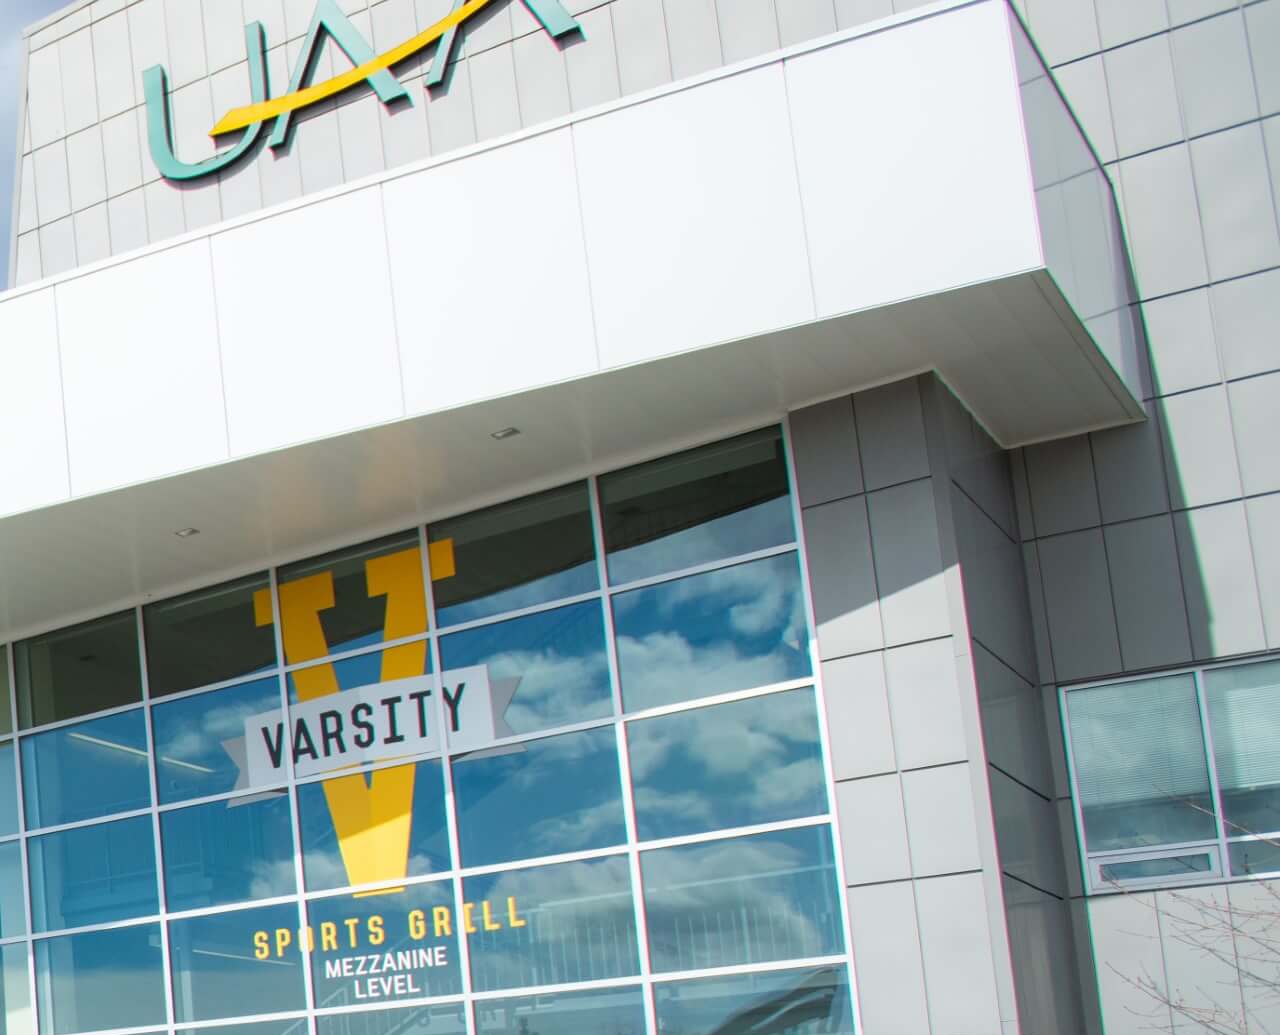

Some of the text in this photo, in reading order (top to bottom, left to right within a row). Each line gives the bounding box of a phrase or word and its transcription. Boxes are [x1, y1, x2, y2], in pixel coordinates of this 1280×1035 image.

[261, 682, 466, 769] VARSITY
[253, 896, 527, 960] SPORTS GRILL
[325, 946, 448, 979] MEZZANINE
[354, 974, 420, 999] LEVEL
